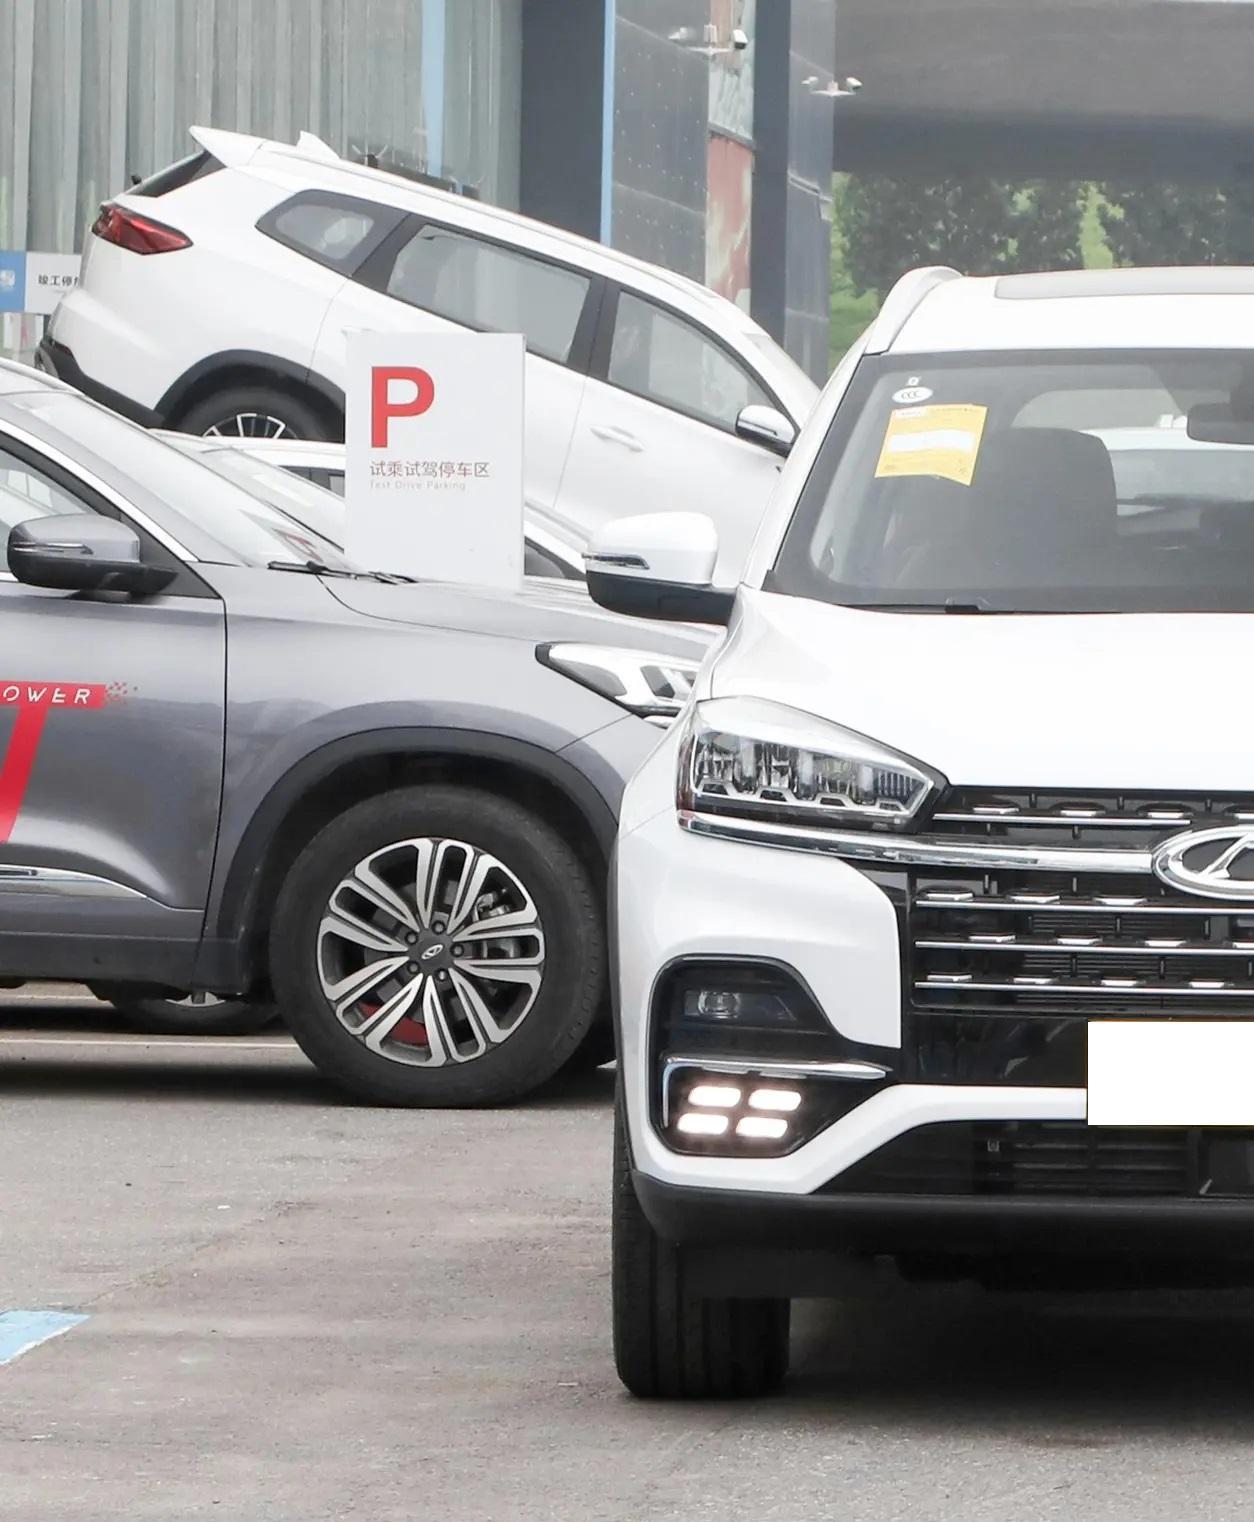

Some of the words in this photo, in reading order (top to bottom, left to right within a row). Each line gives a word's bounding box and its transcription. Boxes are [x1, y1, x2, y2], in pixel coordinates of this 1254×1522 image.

[371, 366, 435, 448] P
[370, 460, 490, 478] 试乘试驾停车区
[370, 480, 390, 489] Test
[395, 480, 421, 489] Drive
[427, 480, 466, 490] Parking
